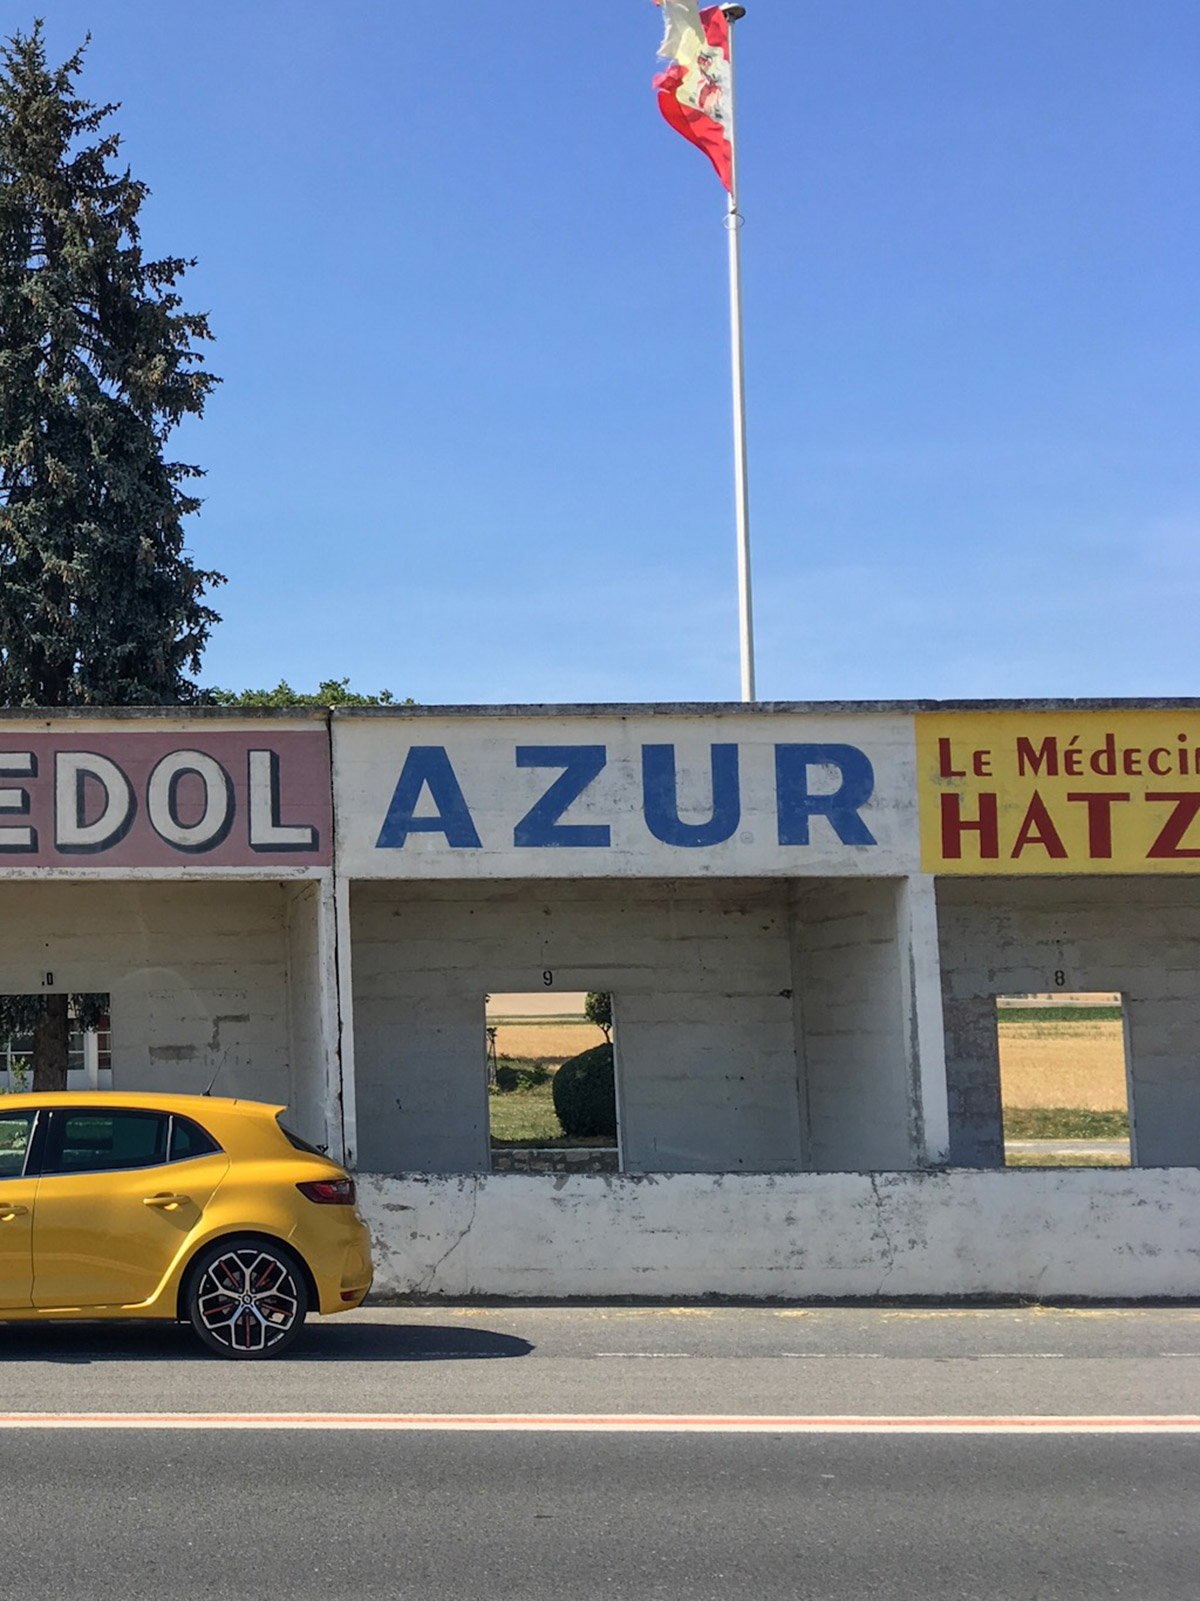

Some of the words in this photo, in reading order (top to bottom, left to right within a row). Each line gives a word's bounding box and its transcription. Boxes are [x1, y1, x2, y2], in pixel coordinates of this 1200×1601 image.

[1016, 733, 1200, 776] Médeci
[374, 743, 879, 849] AZUR
[940, 789, 1200, 859] HATZ
[41, 972, 53, 986] 0
[542, 970, 553, 986] 9
[1054, 970, 1065, 986] 8
